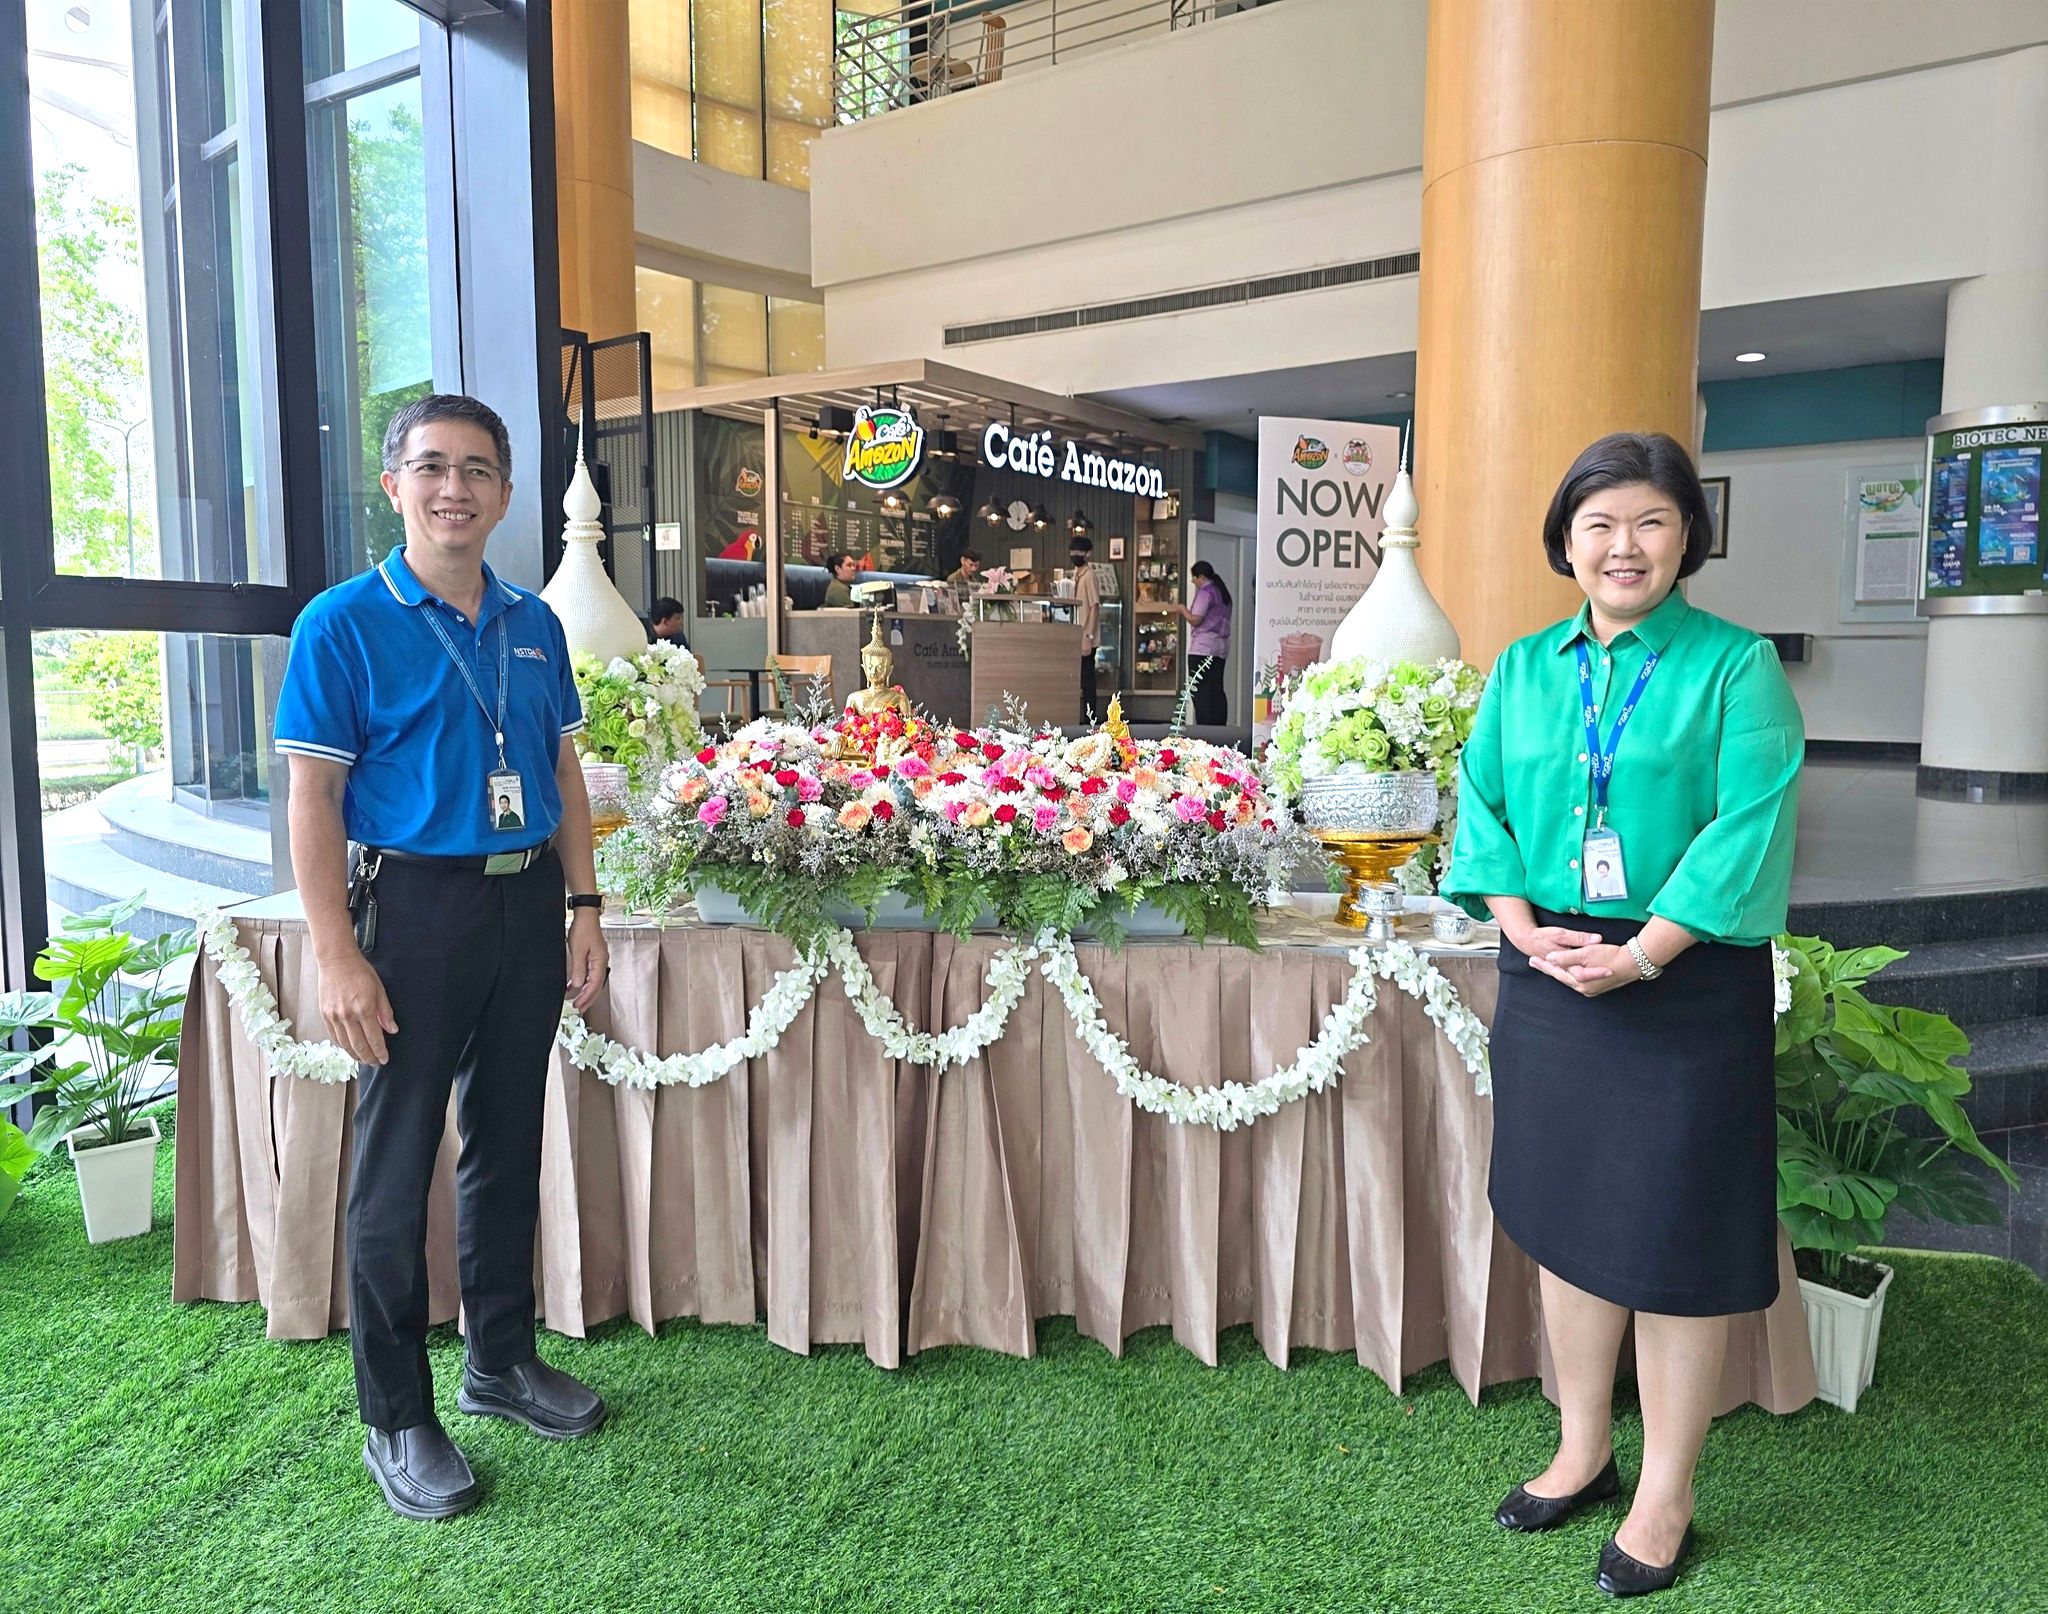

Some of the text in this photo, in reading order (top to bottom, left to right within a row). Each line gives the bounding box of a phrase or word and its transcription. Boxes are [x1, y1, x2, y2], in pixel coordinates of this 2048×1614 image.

[984, 423, 1055, 478] Café
[1953, 428, 2018, 448] BIOTEC
[1277, 478, 1384, 518] NOW
[1276, 528, 1383, 568] OPEN
